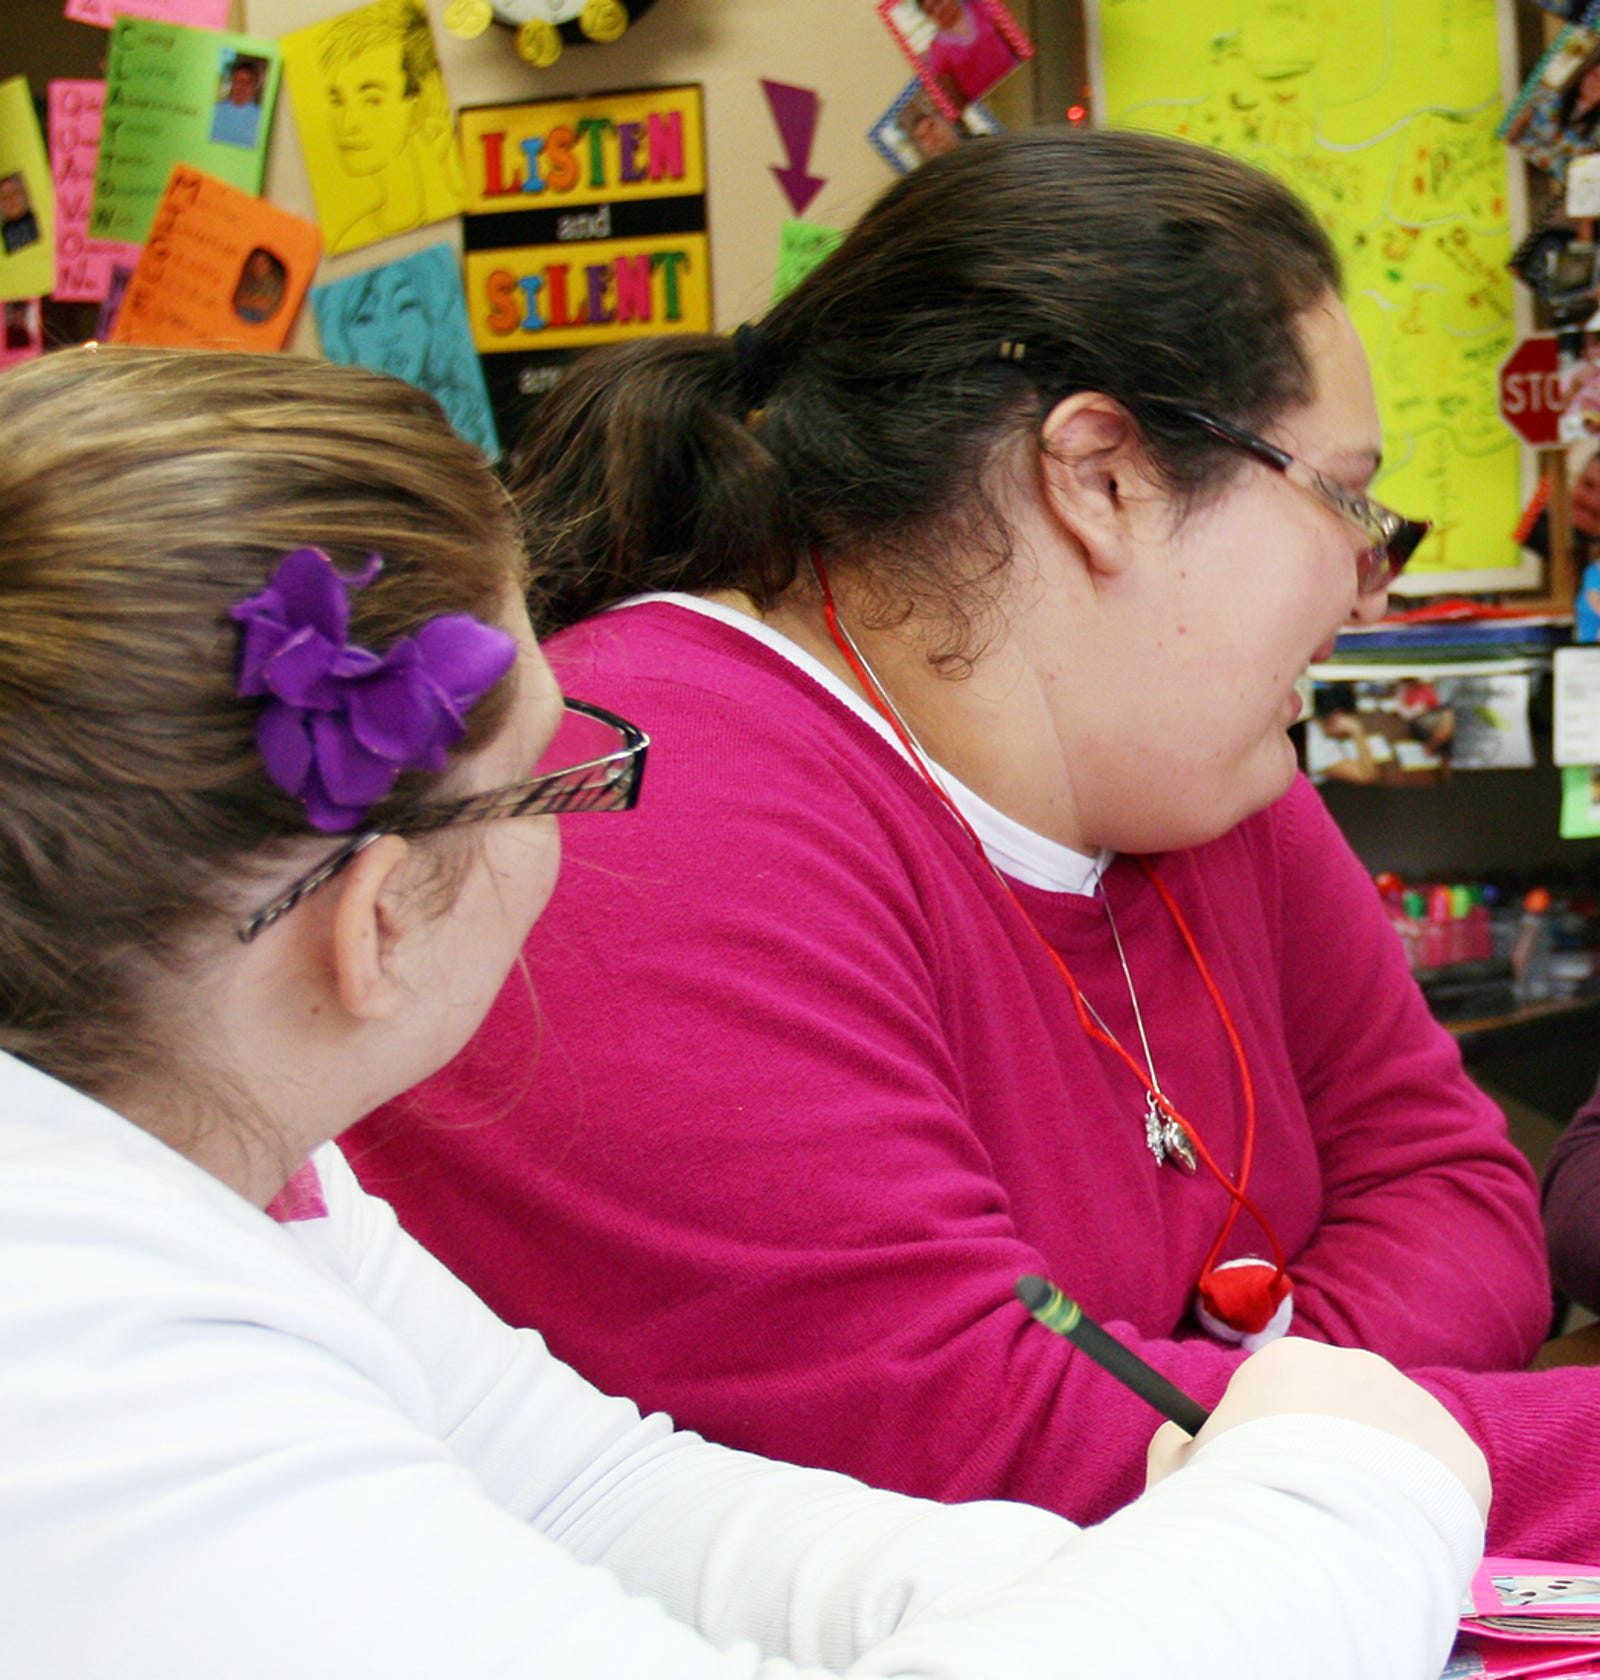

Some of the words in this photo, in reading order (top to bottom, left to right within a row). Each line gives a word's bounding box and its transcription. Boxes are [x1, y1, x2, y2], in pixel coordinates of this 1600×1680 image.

[481, 111, 685, 199] LISTEN
[556, 203, 612, 241] and
[485, 251, 691, 336] SILENT
